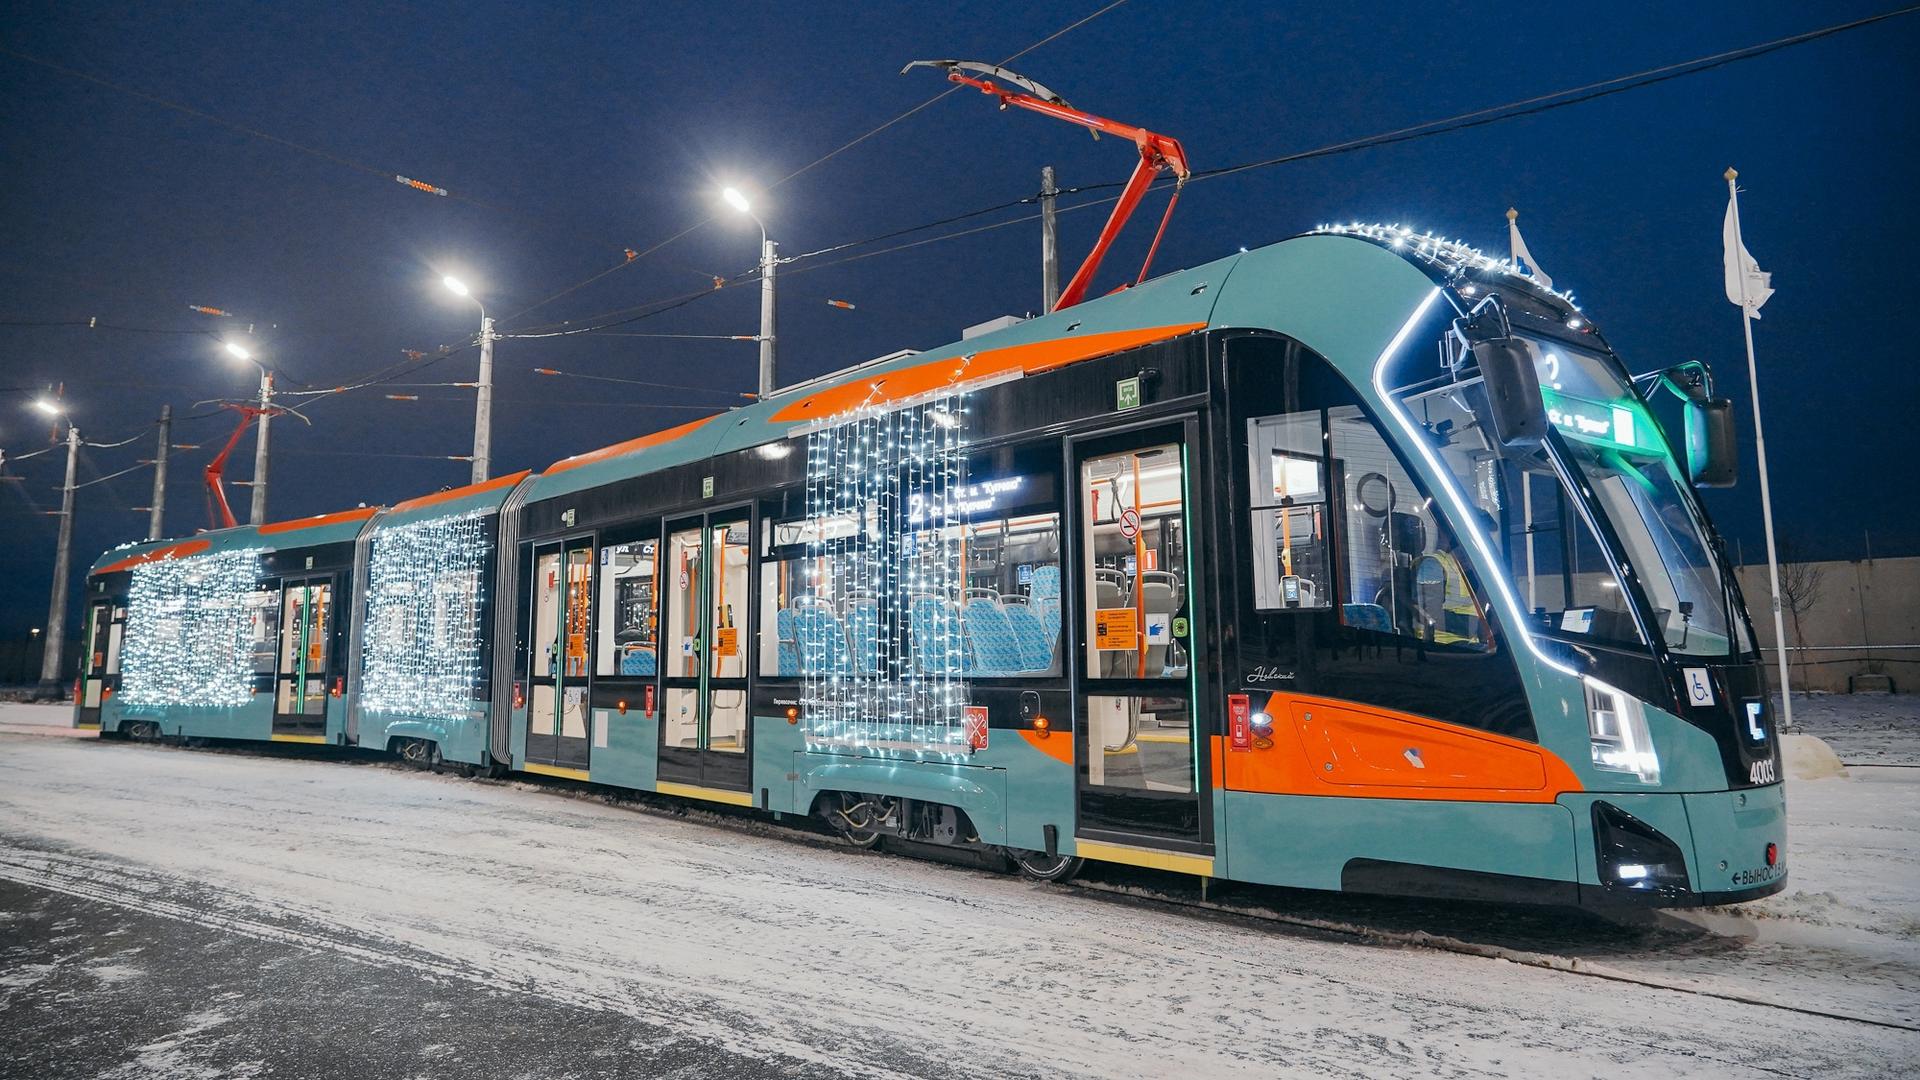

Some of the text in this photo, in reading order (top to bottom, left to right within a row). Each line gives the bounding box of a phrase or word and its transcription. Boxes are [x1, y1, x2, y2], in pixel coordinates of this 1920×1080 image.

[908, 494, 924, 522] 2
[1246, 665, 1296, 683] Невский
[1750, 758, 1775, 785] 4003
[1742, 865, 1773, 885] ВЫНОС
